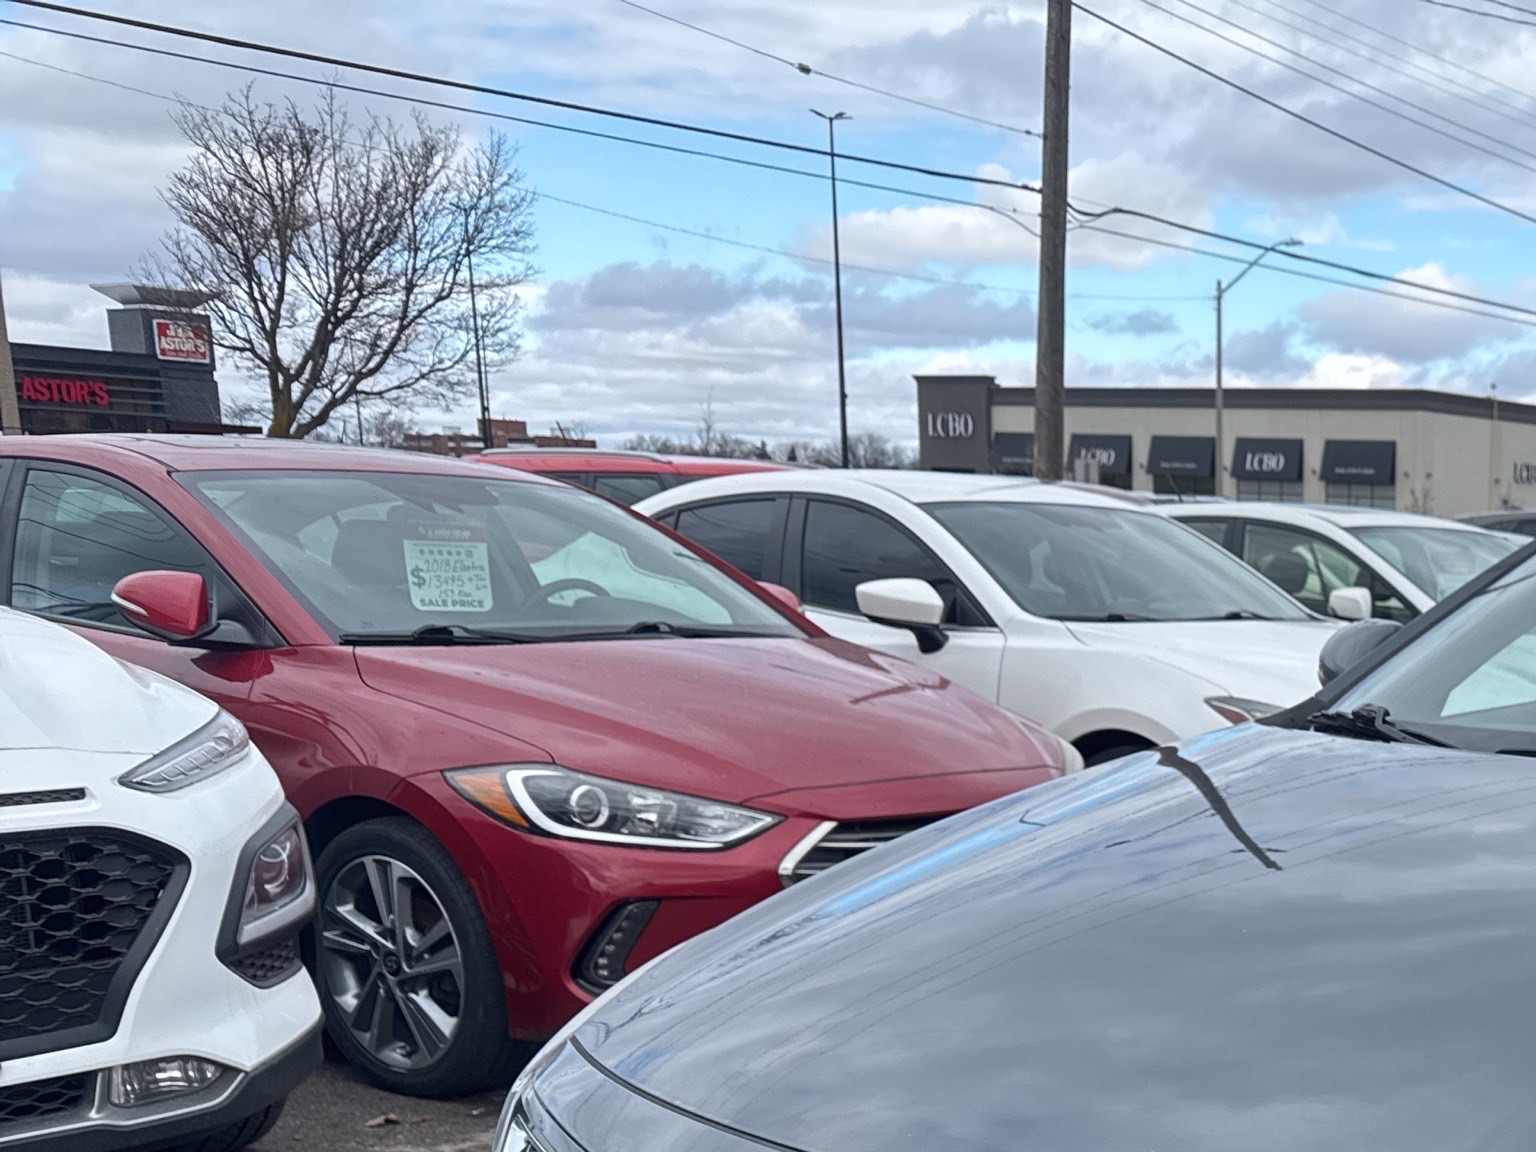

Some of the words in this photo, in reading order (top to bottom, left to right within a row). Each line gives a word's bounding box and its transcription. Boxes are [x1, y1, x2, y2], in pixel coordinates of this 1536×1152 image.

[22, 376, 109, 405] ASTOR'S
[927, 411, 974, 438] LCBO
[1244, 451, 1285, 472] LCBO
[424, 559, 451, 573] 2018
[420, 598, 449, 608] SALE
[451, 599, 485, 608] PRICE
